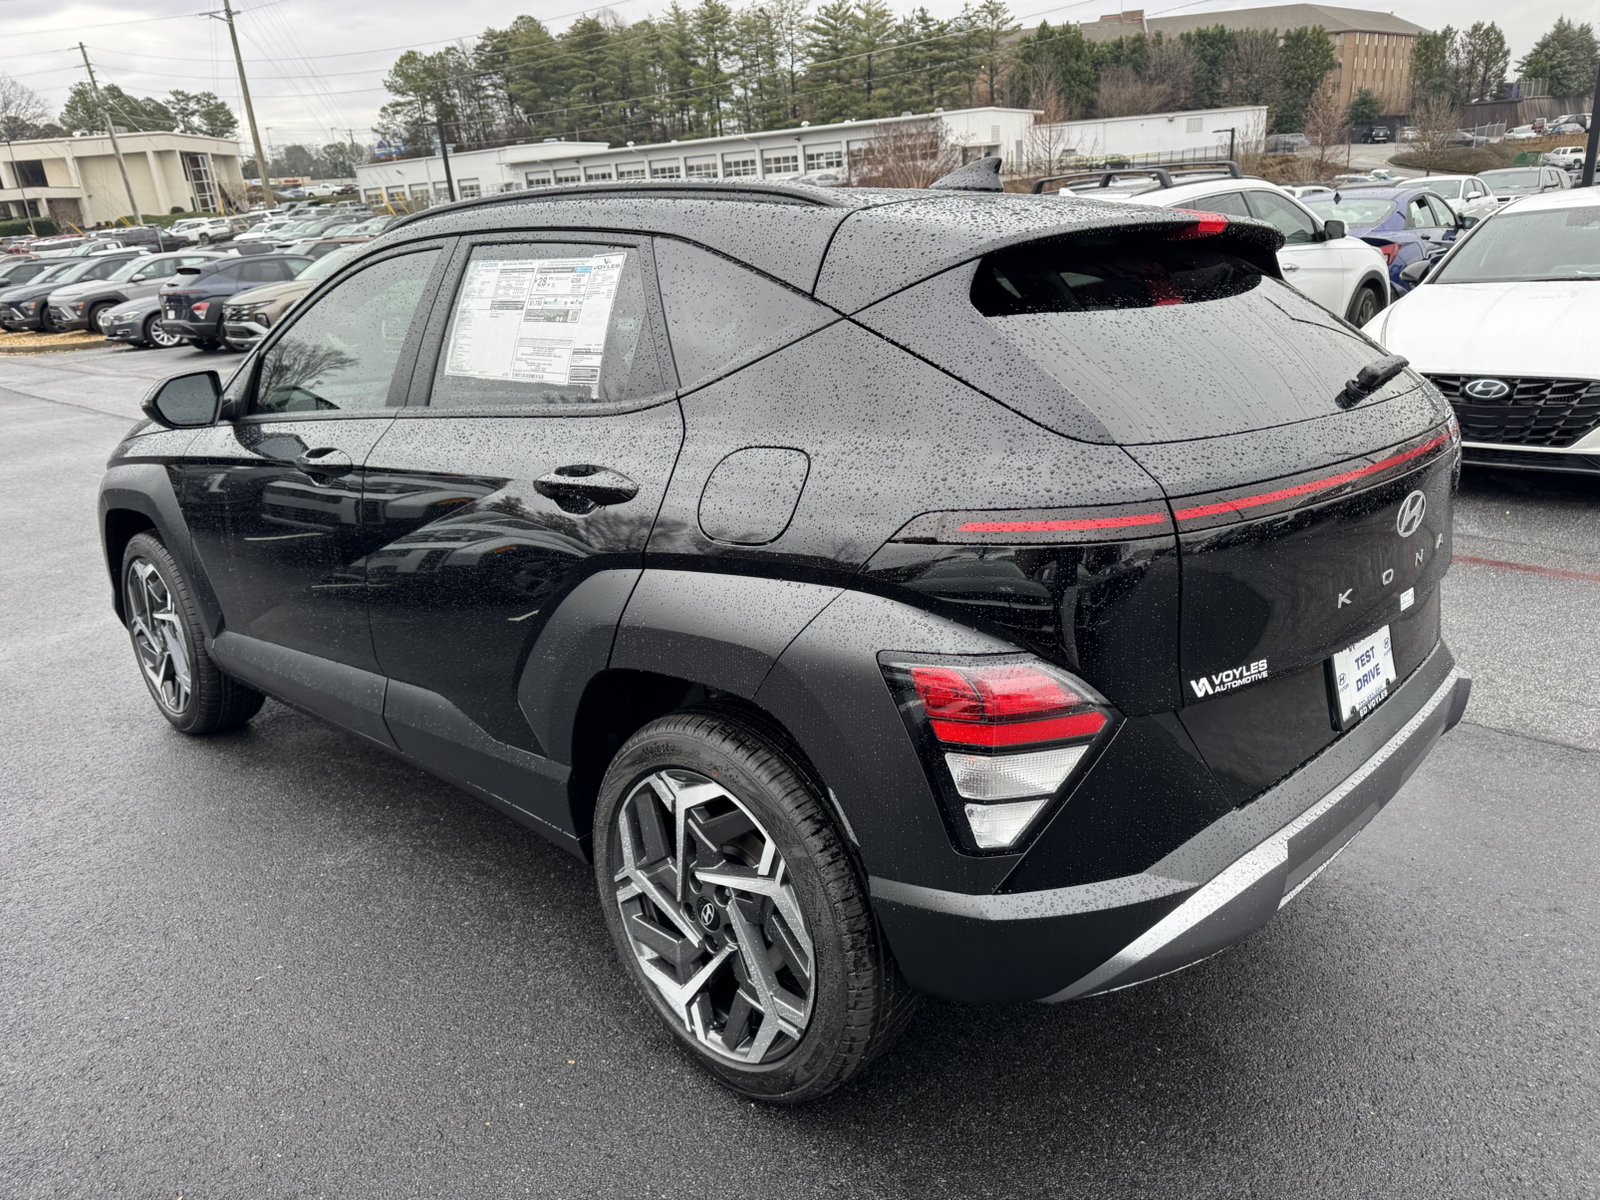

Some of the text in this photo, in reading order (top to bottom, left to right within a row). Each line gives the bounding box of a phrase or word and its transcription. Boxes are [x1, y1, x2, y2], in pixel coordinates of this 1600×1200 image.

[1337, 532, 1444, 609] KONA
[1211, 659, 1268, 685] VOYLES
[1354, 646, 1375, 671] TEST
[1214, 670, 1269, 693] AUTOMOTIVE
[1356, 663, 1381, 692] DRIVE
[1359, 706, 1368, 718] ED
[1367, 688, 1389, 710] VOYLES
